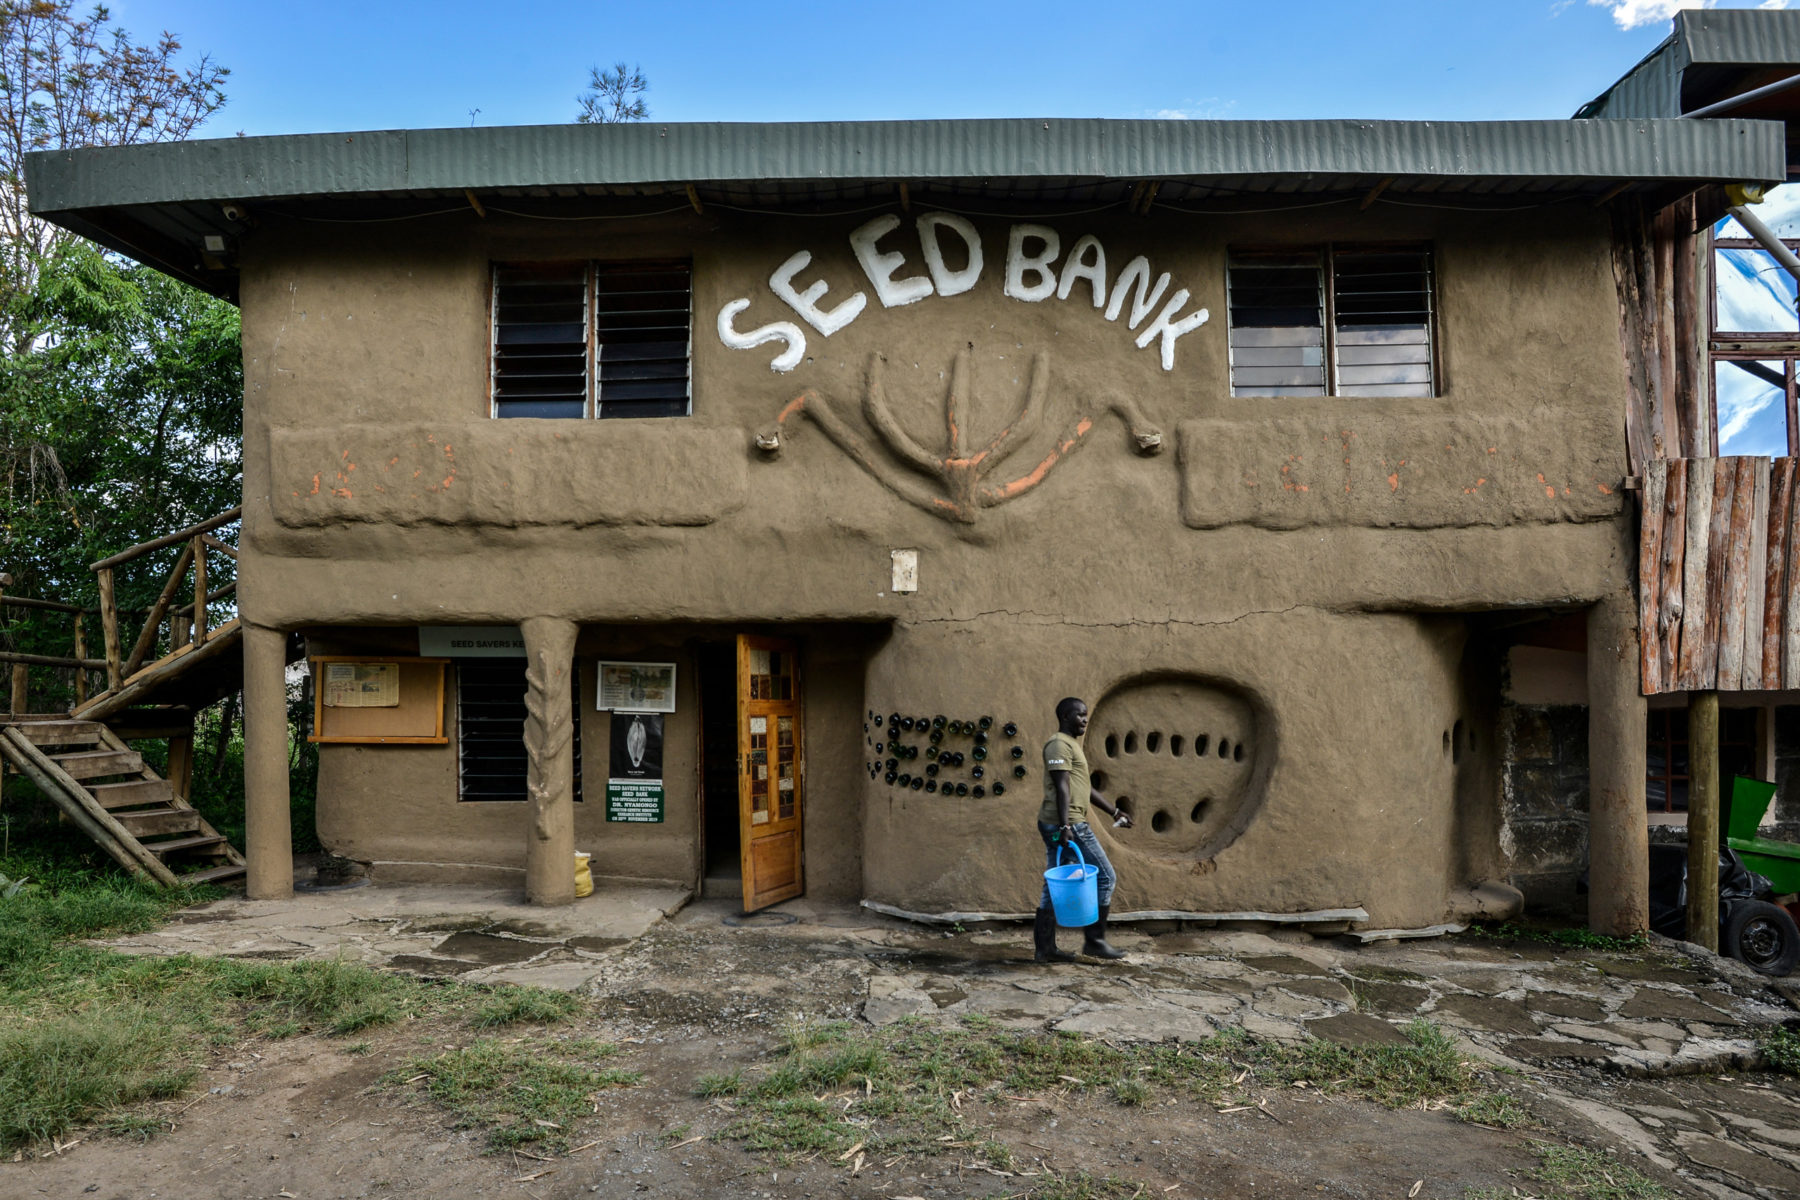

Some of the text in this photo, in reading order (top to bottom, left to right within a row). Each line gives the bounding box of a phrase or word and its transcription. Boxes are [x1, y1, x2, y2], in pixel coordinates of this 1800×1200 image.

[717, 211, 1209, 373] SEED BANK
[451, 640, 525, 648] SEED SAVERS KE
